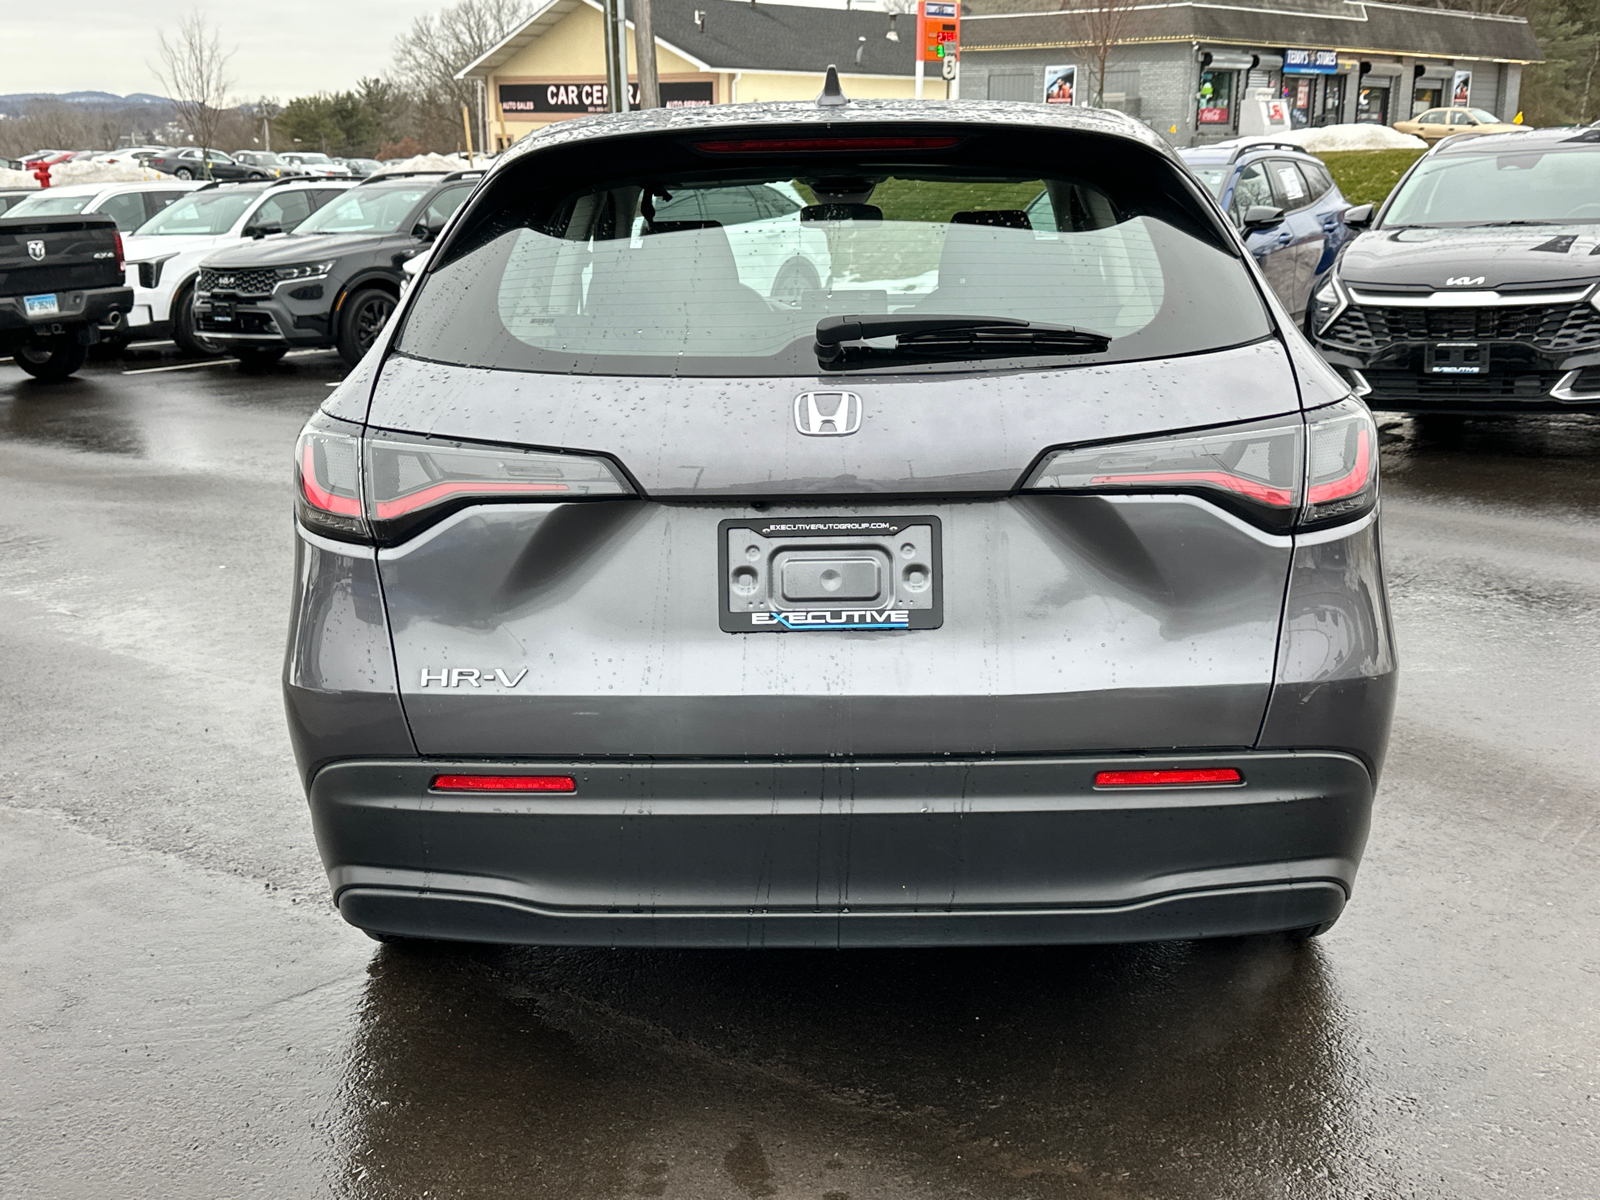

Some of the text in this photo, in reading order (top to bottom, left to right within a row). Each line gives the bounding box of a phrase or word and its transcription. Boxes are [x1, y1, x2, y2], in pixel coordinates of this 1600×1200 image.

[1316, 51, 1336, 65] STORES
[946, 60, 952, 75] 5
[547, 85, 579, 105] CAR
[502, 101, 534, 111] AUTO SALES
[769, 522, 890, 532] EXECUTIVEAUTOGROUP.COM
[751, 610, 909, 628] EXECUTIVE
[420, 668, 529, 688] HR-V
